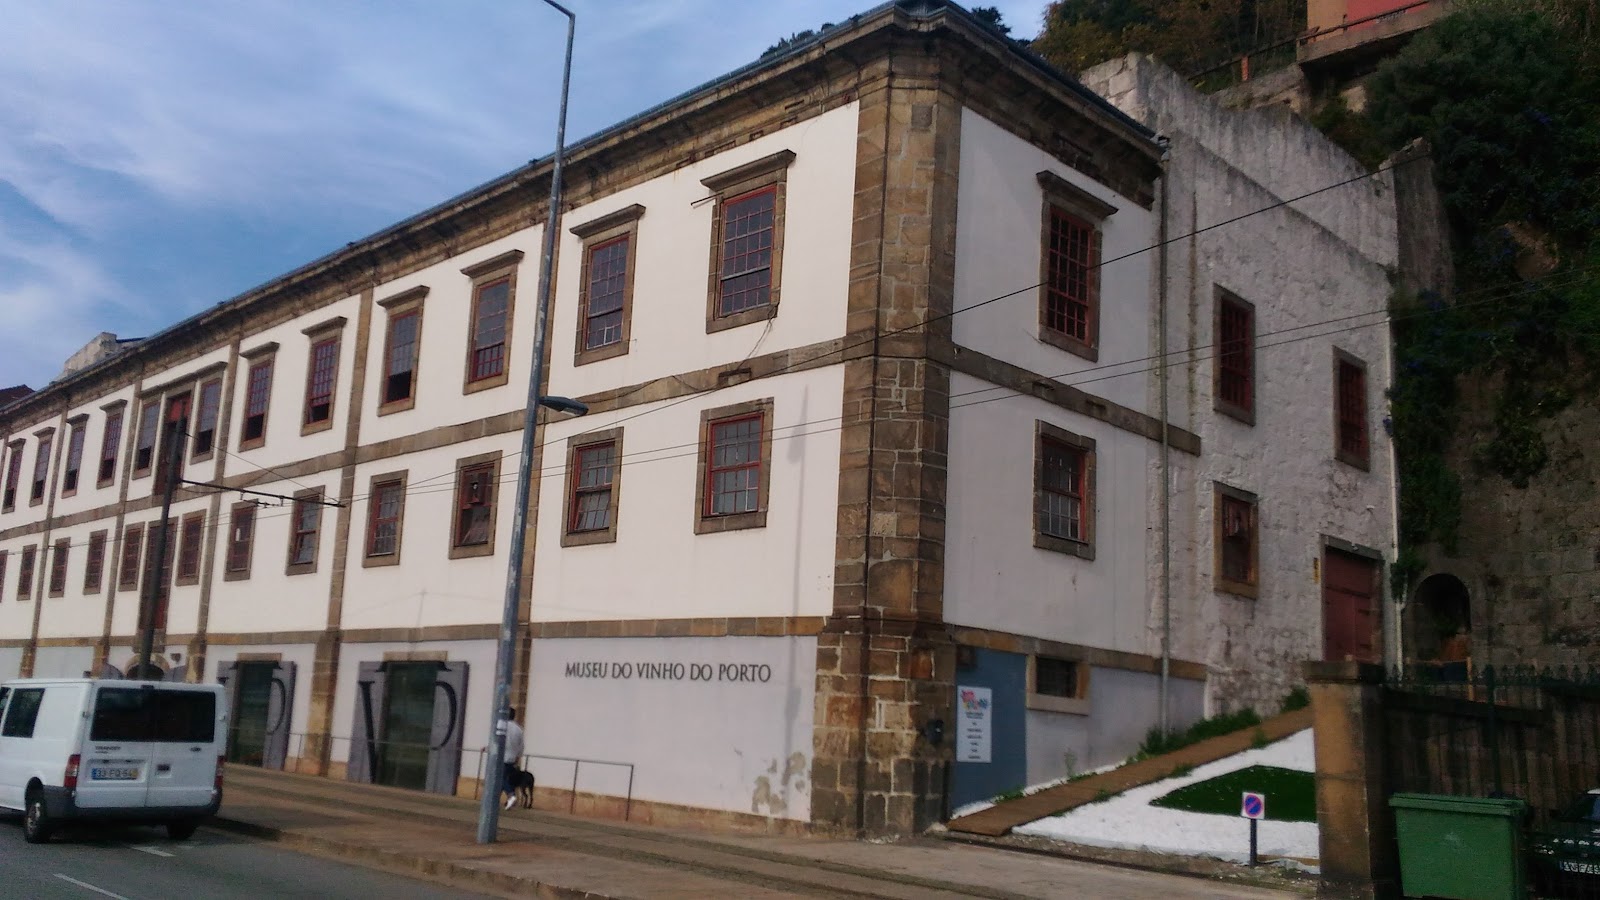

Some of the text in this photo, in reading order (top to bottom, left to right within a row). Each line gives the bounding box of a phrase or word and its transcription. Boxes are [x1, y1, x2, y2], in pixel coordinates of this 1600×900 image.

[565, 662, 771, 682] MUSEU DO VINHO DO PORTO
